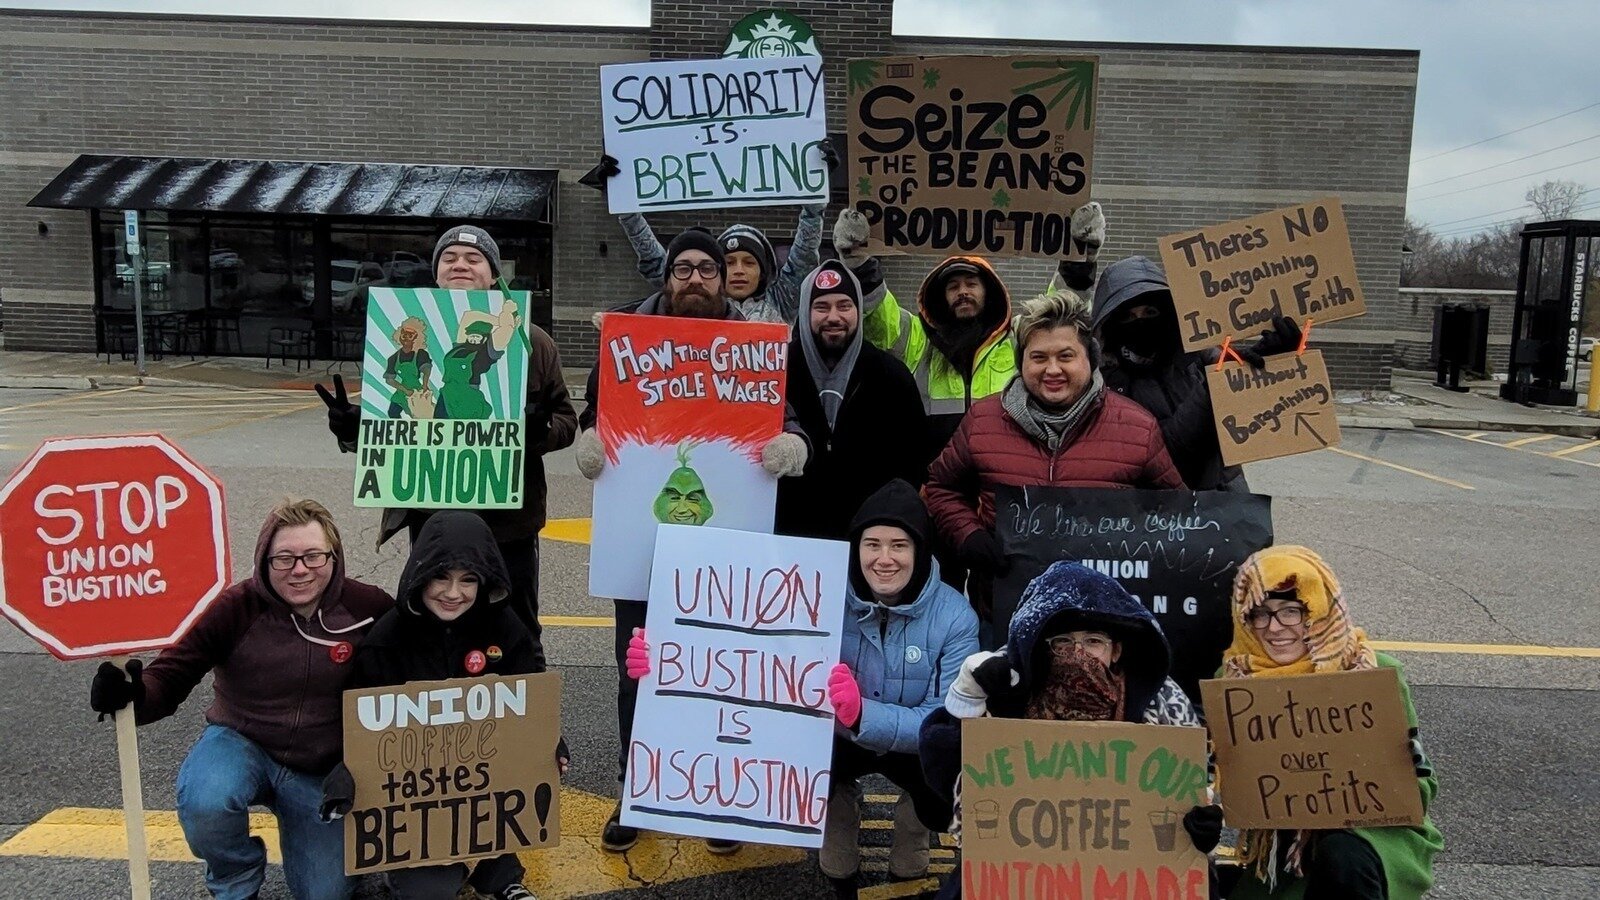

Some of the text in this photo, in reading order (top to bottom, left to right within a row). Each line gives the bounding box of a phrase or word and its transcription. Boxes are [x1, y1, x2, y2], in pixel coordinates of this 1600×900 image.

[613, 64, 824, 124] SOLIDARITY
[858, 86, 1048, 153] Seize
[634, 141, 826, 198] BREWING
[859, 155, 916, 175] THE
[929, 152, 1085, 196] BEANS
[1171, 206, 1329, 267] There's NO
[1200, 254, 1318, 298] Bargaining
[1571, 252, 1585, 322] STARBUCKS
[1184, 276, 1354, 343] In Good Faith
[710, 336, 788, 373] GRINCH
[1225, 355, 1308, 393] Without
[637, 372, 781, 407] STOLE WAGES
[1222, 383, 1329, 444] Bargaining
[361, 448, 386, 467] IN
[362, 419, 521, 447] THERE IS POWER
[358, 449, 522, 504] A UNION!
[34, 476, 188, 545] STOP
[47, 540, 154, 575] UNION
[43, 569, 167, 607] BUSTING
[658, 641, 826, 709] BUSTING
[358, 679, 526, 731] UNION
[719, 707, 751, 735] IS
[1225, 687, 1374, 746] Partners
[382, 762, 489, 802] tastes
[630, 740, 831, 825] DISGUSTING
[964, 739, 1207, 803] WE WANT OUR
[1281, 751, 1329, 770] over
[1257, 770, 1385, 819] Profits
[352, 783, 552, 869] BETTER!
[1009, 798, 1131, 851] COFFEE
[964, 858, 1082, 900] UNION
